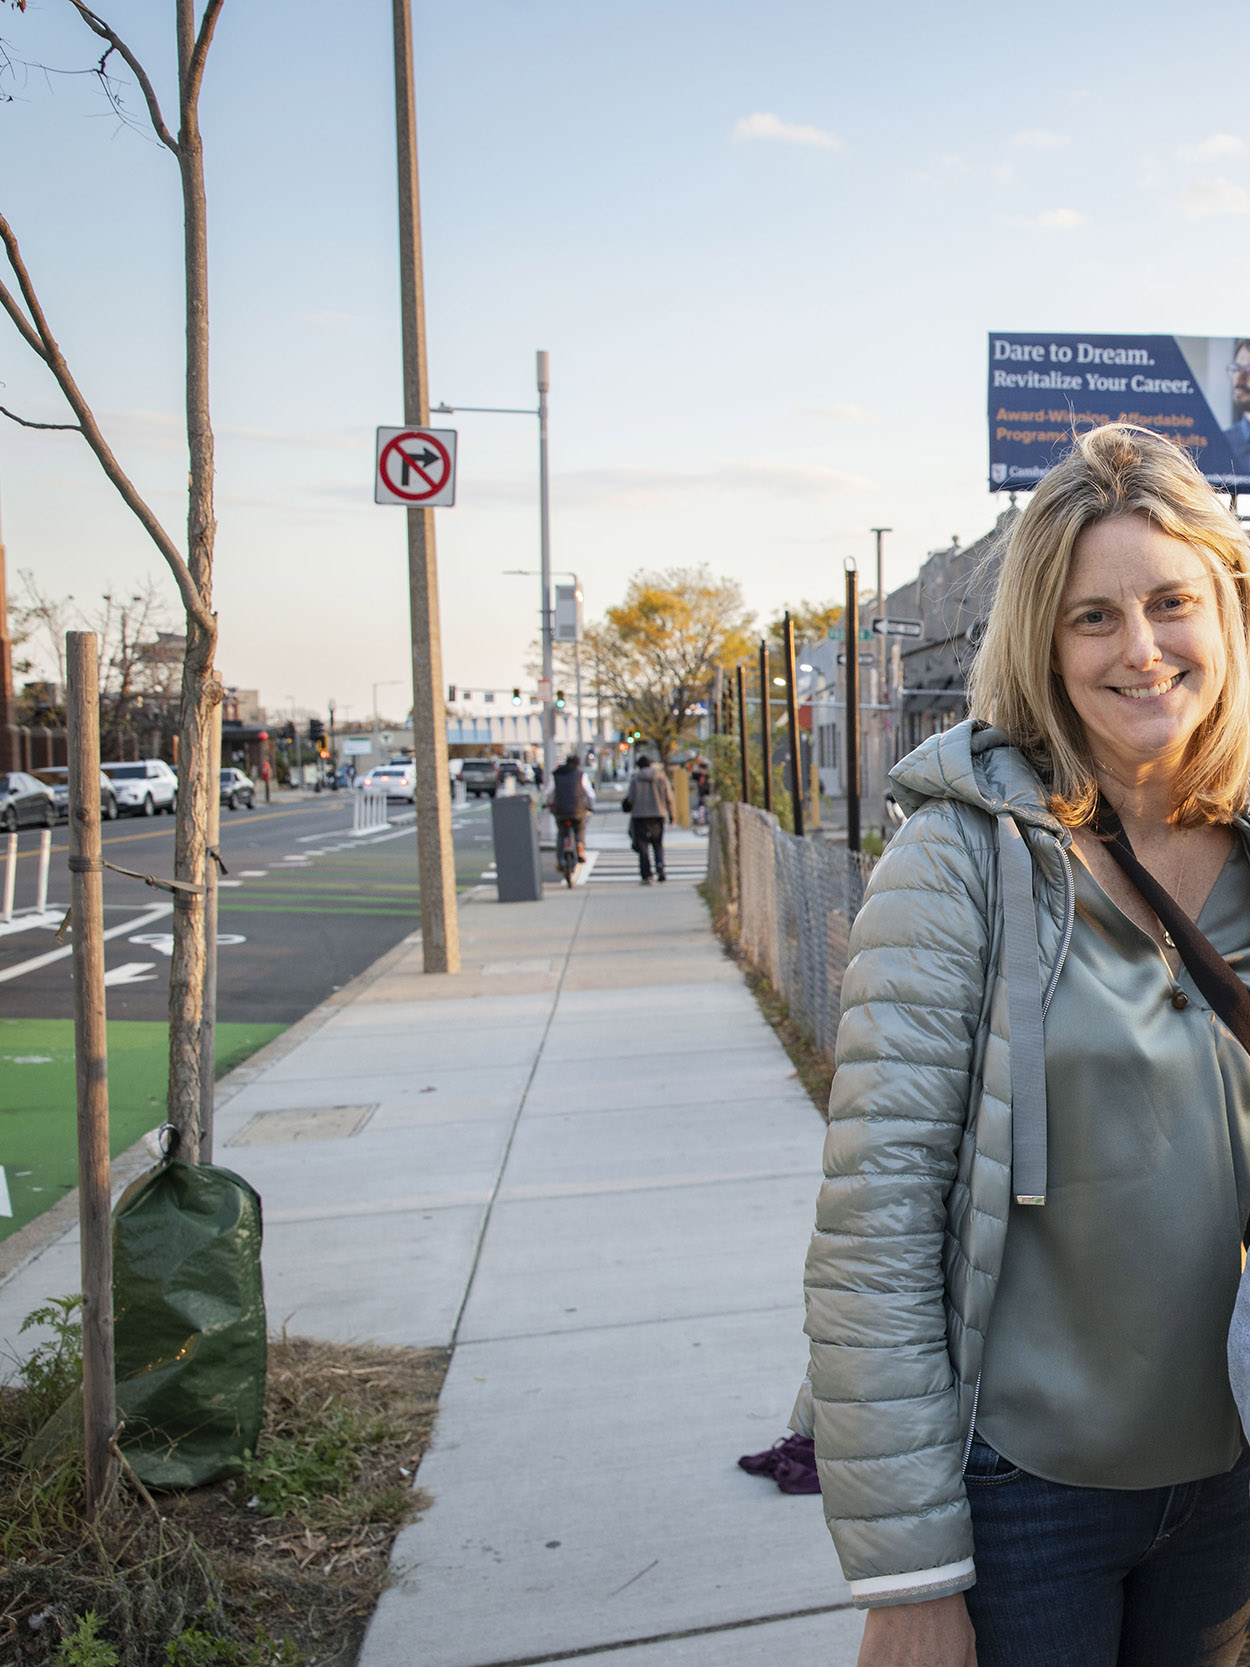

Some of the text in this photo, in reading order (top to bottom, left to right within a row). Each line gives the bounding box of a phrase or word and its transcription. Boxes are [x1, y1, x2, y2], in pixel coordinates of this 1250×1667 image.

[994, 339, 1156, 366] Dare to Dream.
[993, 370, 1194, 394] Revitalize Your Career.
[995, 427, 1068, 444] Programs
